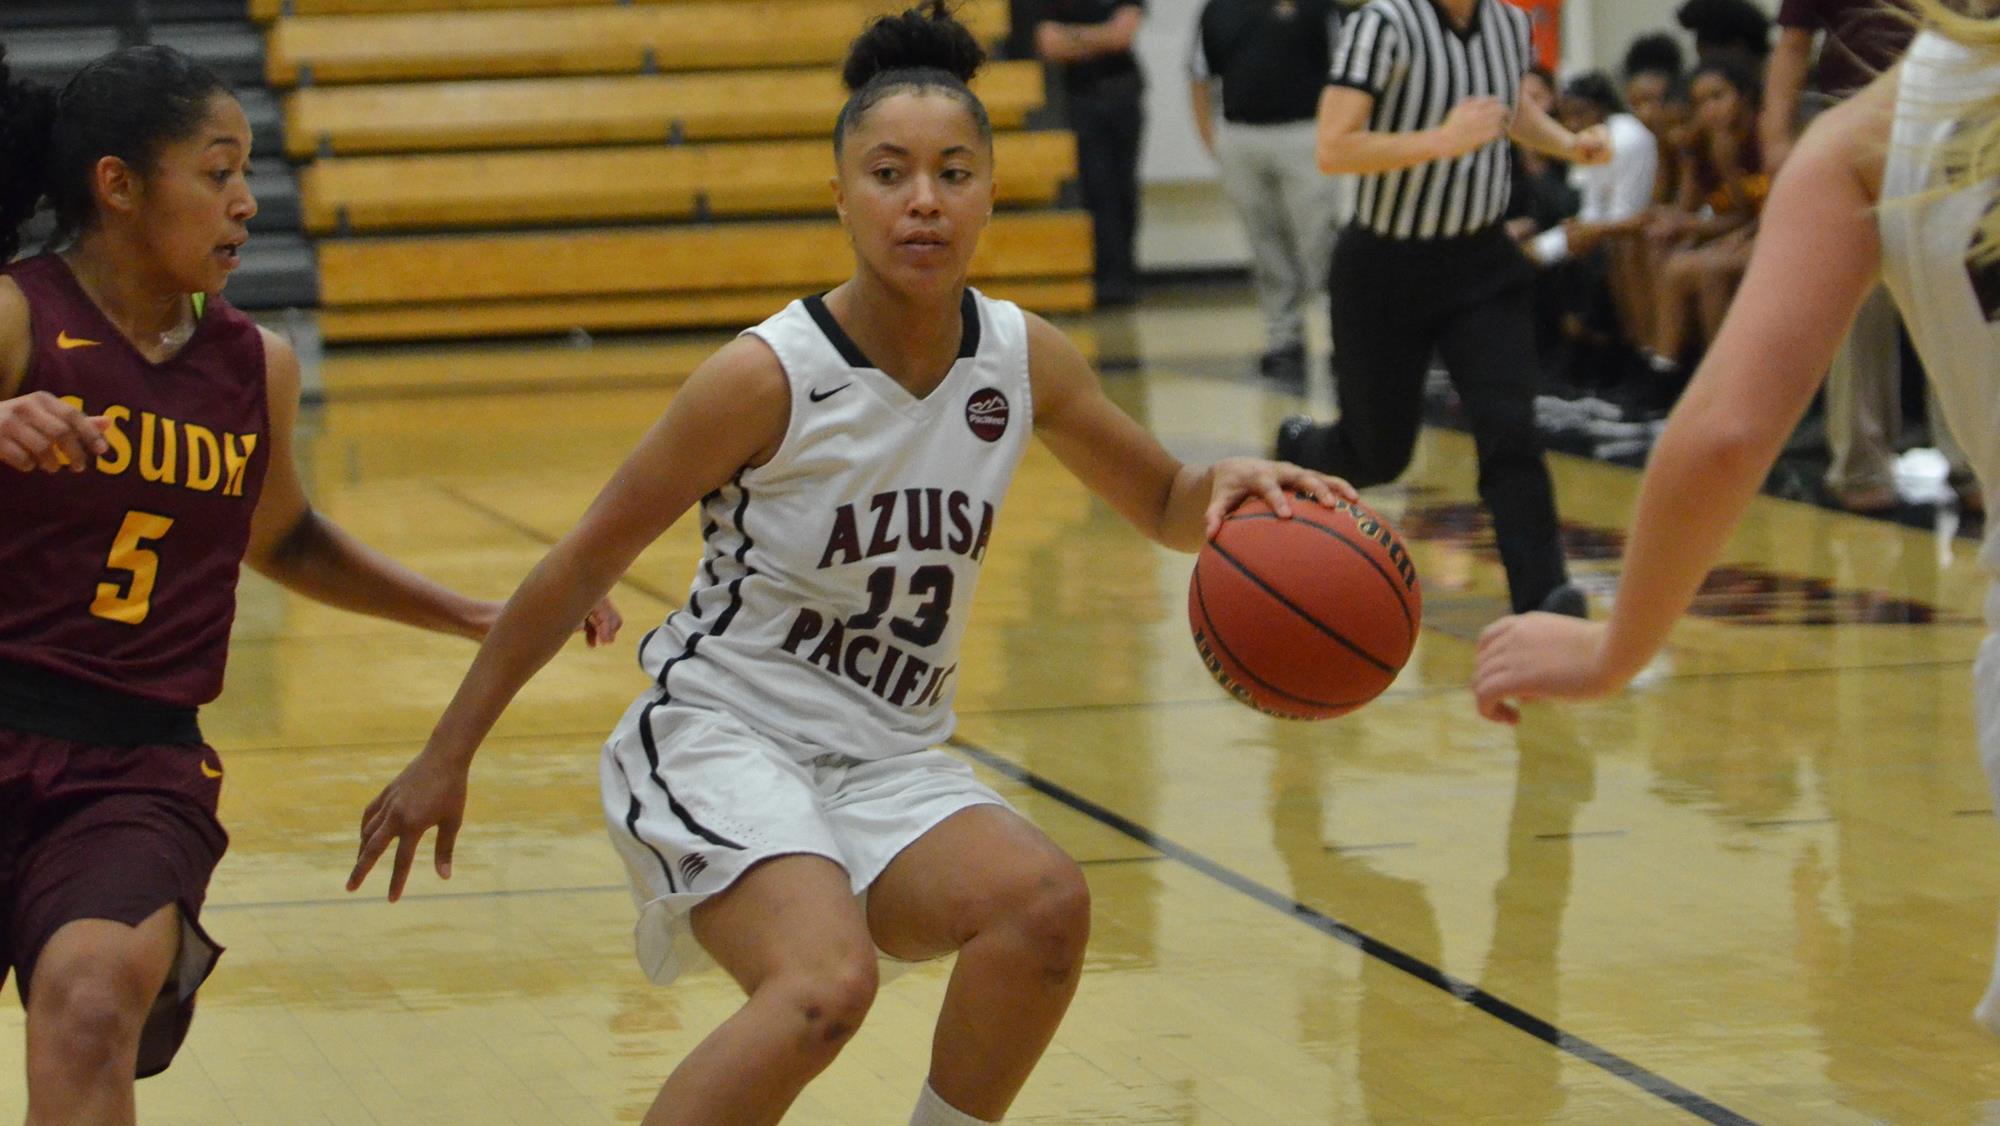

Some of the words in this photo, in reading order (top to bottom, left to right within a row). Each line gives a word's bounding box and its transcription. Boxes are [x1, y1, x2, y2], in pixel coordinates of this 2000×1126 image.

[53, 396, 258, 497] SUDH
[89, 510, 174, 624] 5
[817, 487, 995, 570] AZUSA
[845, 564, 956, 648] 13
